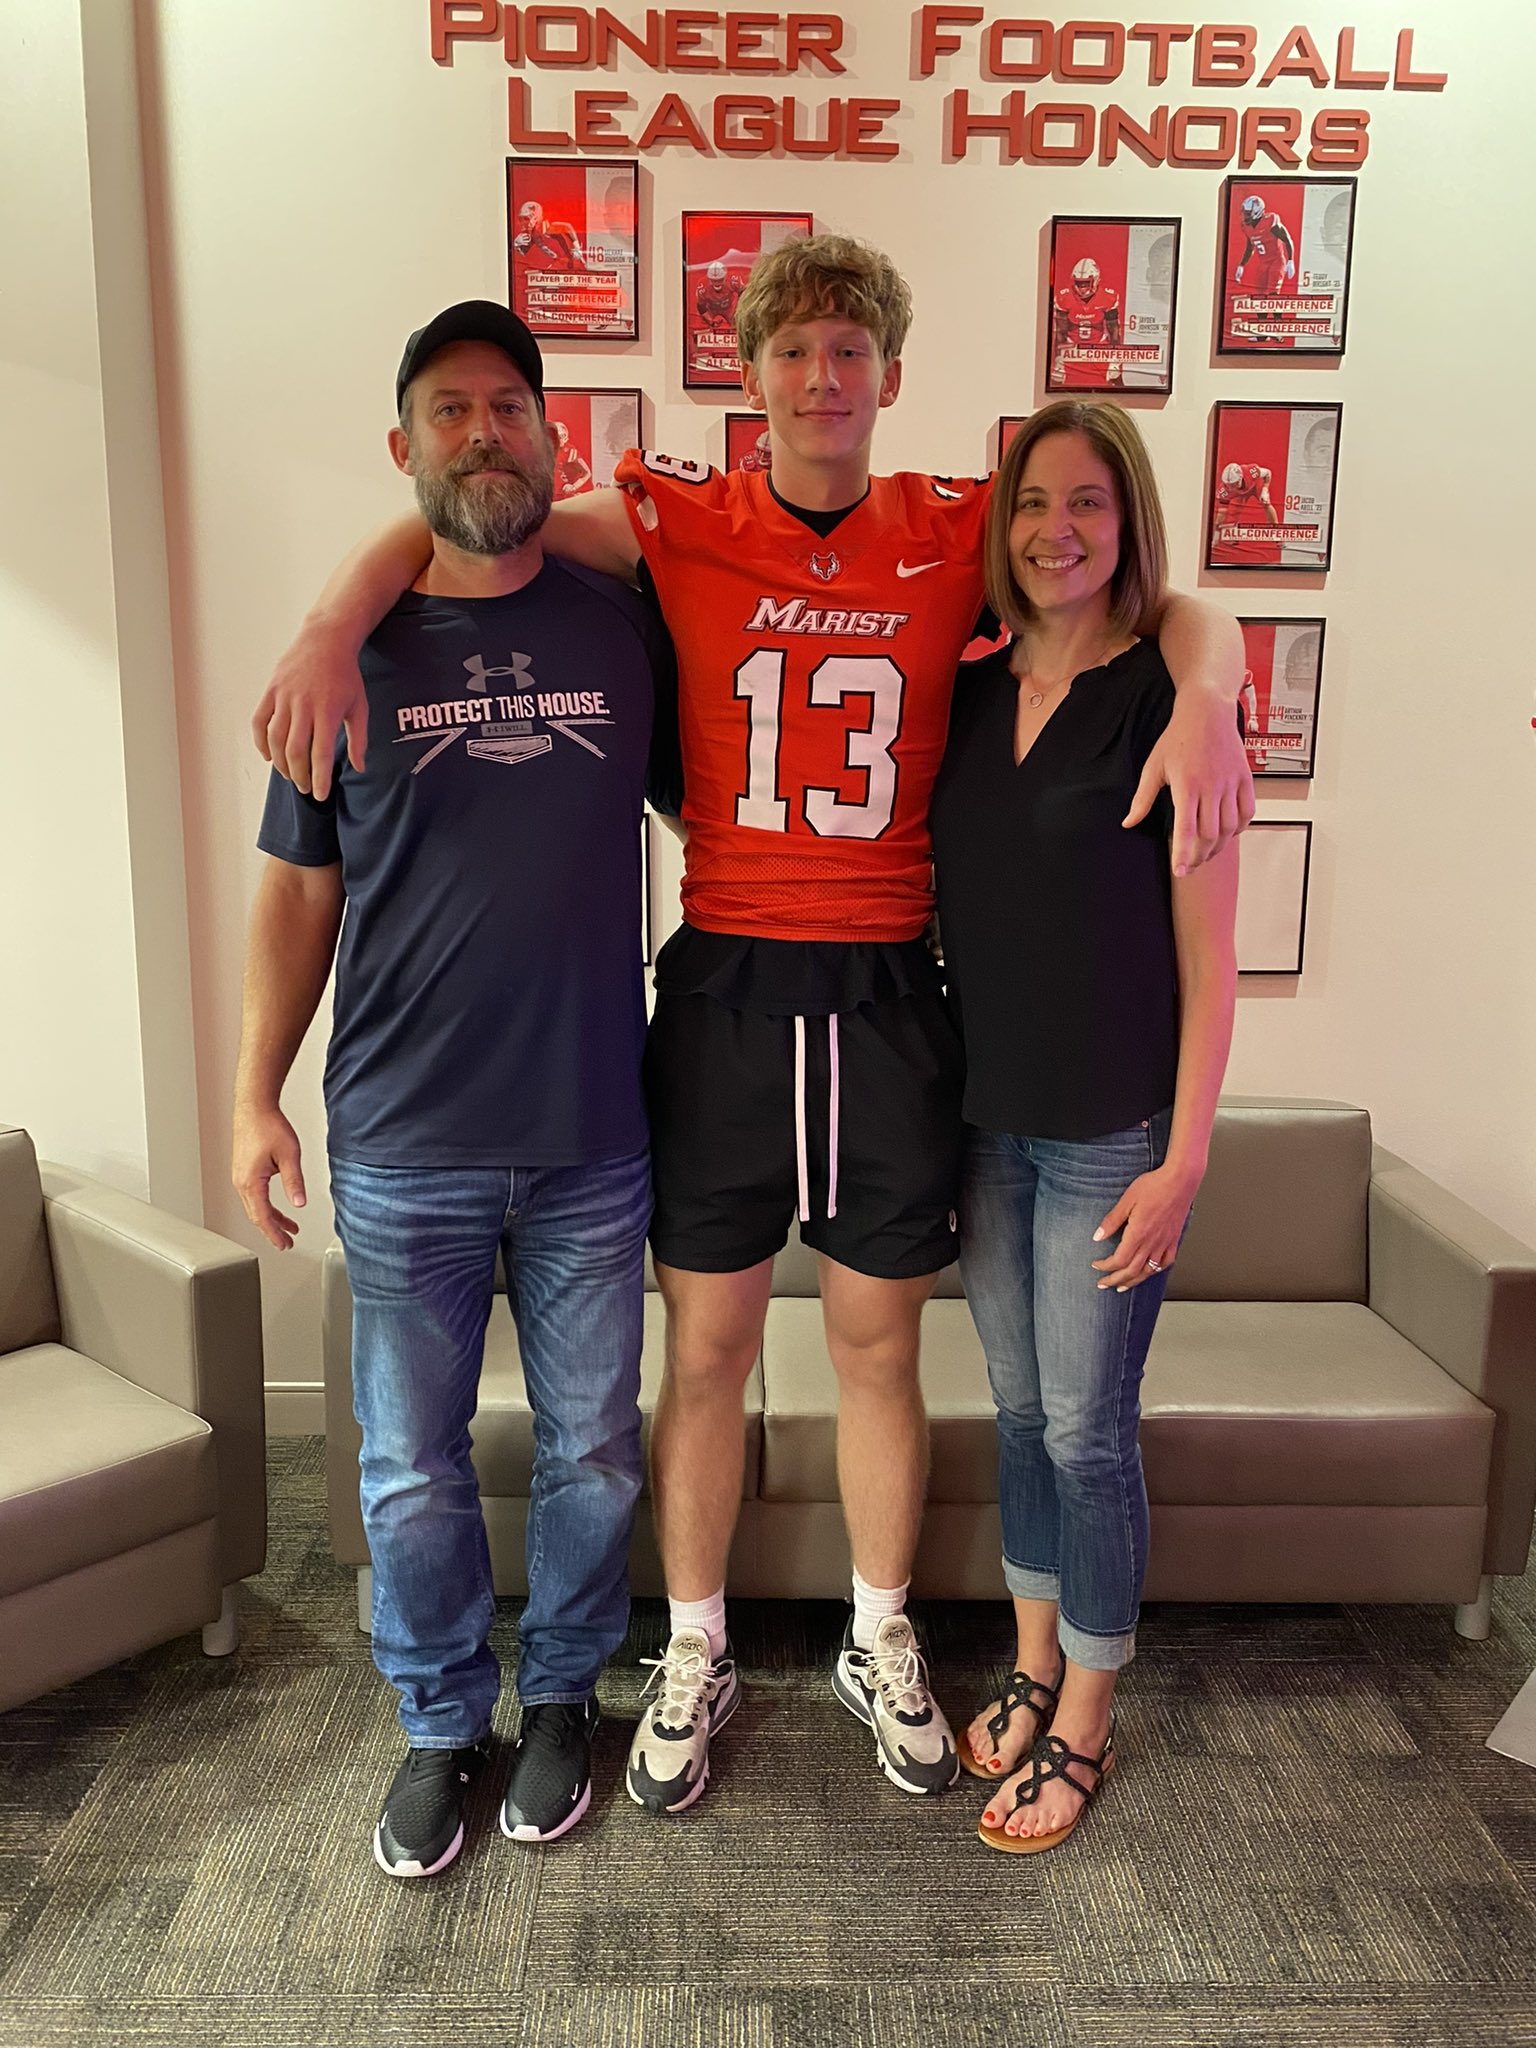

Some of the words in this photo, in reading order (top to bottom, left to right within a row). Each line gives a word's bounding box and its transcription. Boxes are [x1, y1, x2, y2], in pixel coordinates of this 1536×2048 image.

[430, 0, 846, 73] PIONEER
[921, 5, 1448, 91] FOOTBALL
[508, 77, 901, 155] LEAGUE
[951, 89, 1371, 165] HONORS
[1303, 270, 1311, 288] 5
[530, 293, 617, 304] ALL-CONFERENCE
[1236, 300, 1333, 310] ALL-CONFERENCE
[530, 312, 617, 322] ALL-CONFERENCE
[1129, 314, 1137, 331] 6
[1234, 323, 1331, 333] ALL-CONFERENCE
[1063, 349, 1160, 360] ALL-CONFERENCE
[1285, 495, 1301, 511] 92
[1223, 529, 1319, 539] ALL-CONFERENCE
[744, 596, 908, 638] MARIST
[397, 697, 493, 732] PROTECT
[496, 694, 536, 720] THIS
[537, 690, 611, 717] HOUSE.
[1269, 705, 1285, 720] 44
[733, 647, 907, 840] 13
